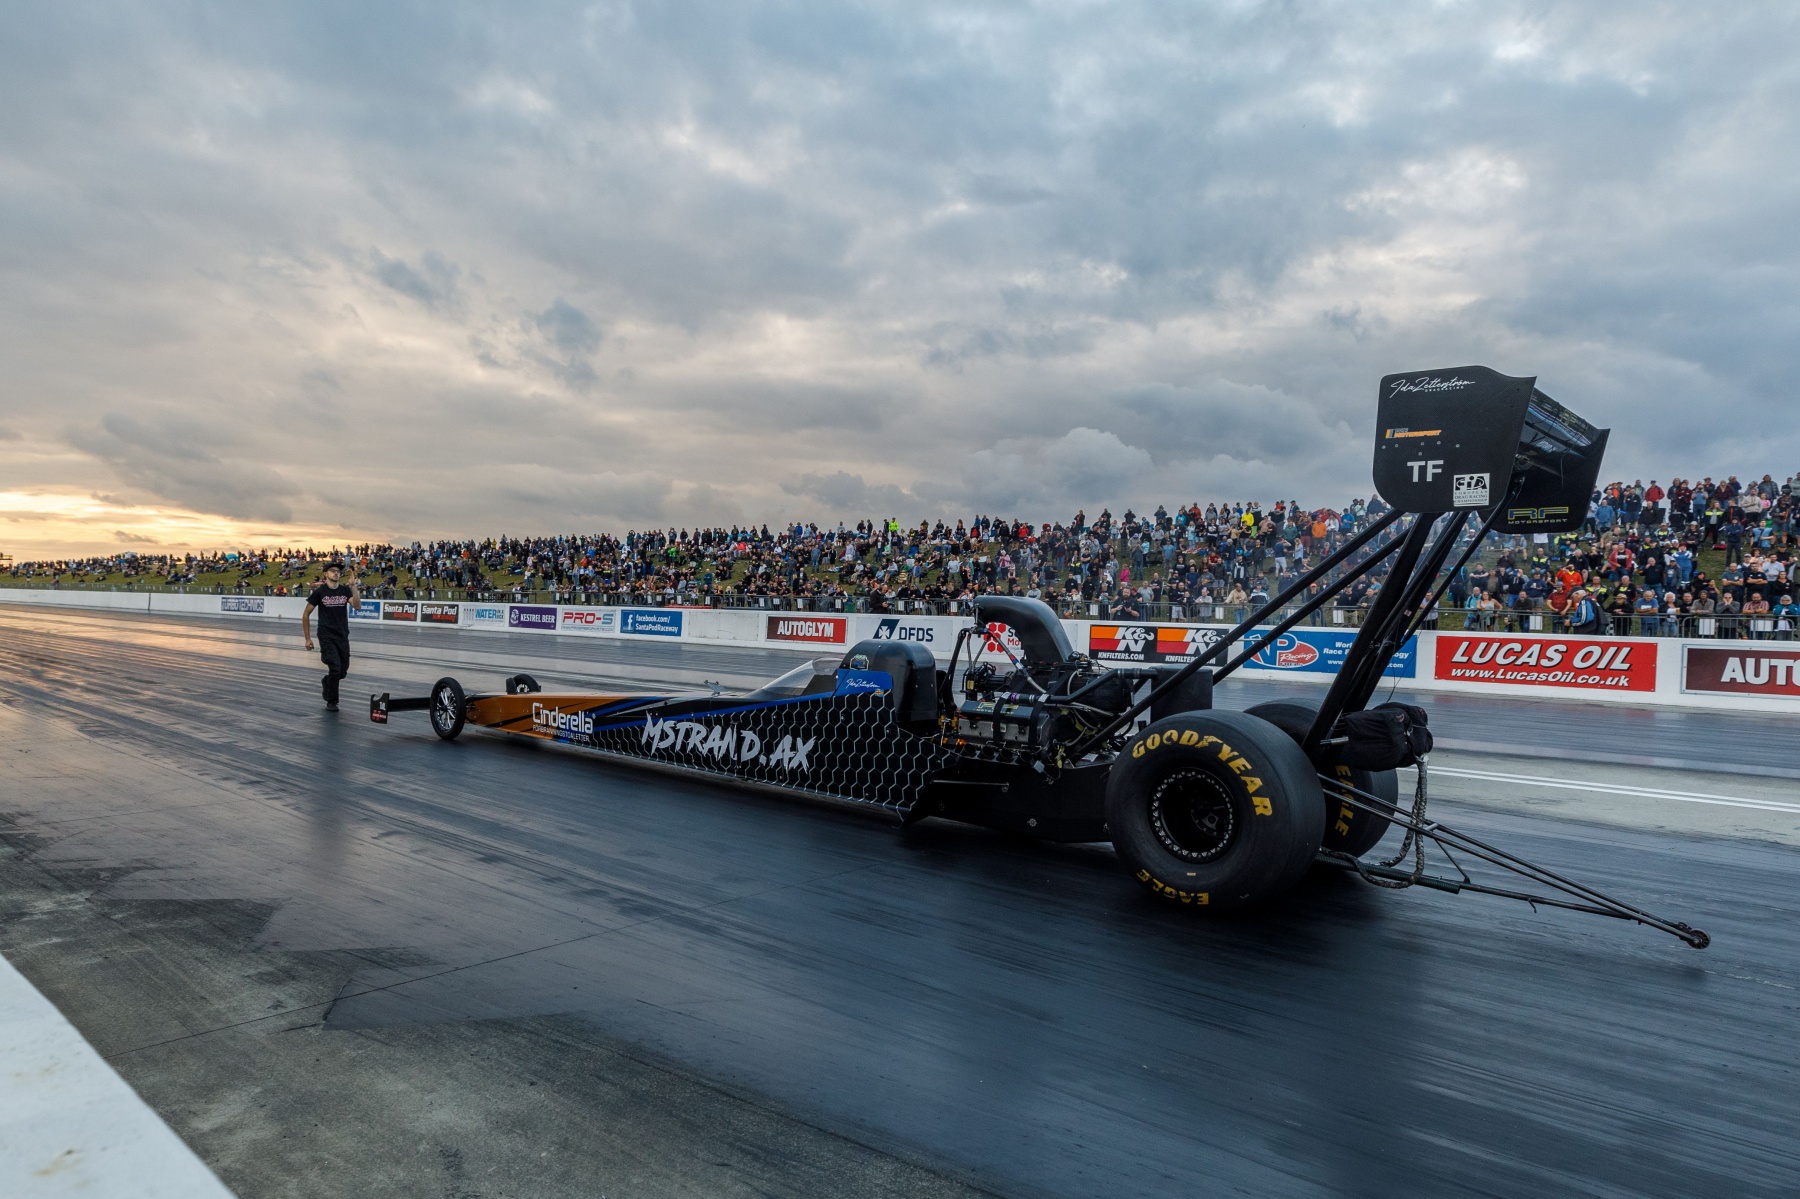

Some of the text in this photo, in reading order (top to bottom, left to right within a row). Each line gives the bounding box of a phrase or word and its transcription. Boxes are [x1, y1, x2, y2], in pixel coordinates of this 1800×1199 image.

[1406, 459, 1444, 482] TF
[384, 604, 417, 613] Santa Pod
[422, 605, 457, 615] Santa Pod
[475, 608, 497, 619] WATER
[520, 614, 555, 623] KESTREL BEER
[563, 612, 614, 625] PRO-S
[636, 614, 671, 624] facebook.com/
[635, 624, 679, 634] SantaPodRaceway
[777, 620, 834, 638] AUTOGLYM
[899, 626, 933, 642] DFDS
[1097, 651, 1145, 661] KNFILTERS.COM
[1323, 647, 1343, 655] Race
[1451, 641, 1633, 671] LUCAS OIL
[1451, 668, 1630, 687] www.LucasOil.co.uk
[532, 702, 593, 734] Cinderella
[1132, 729, 1273, 817] GOODYEAR
